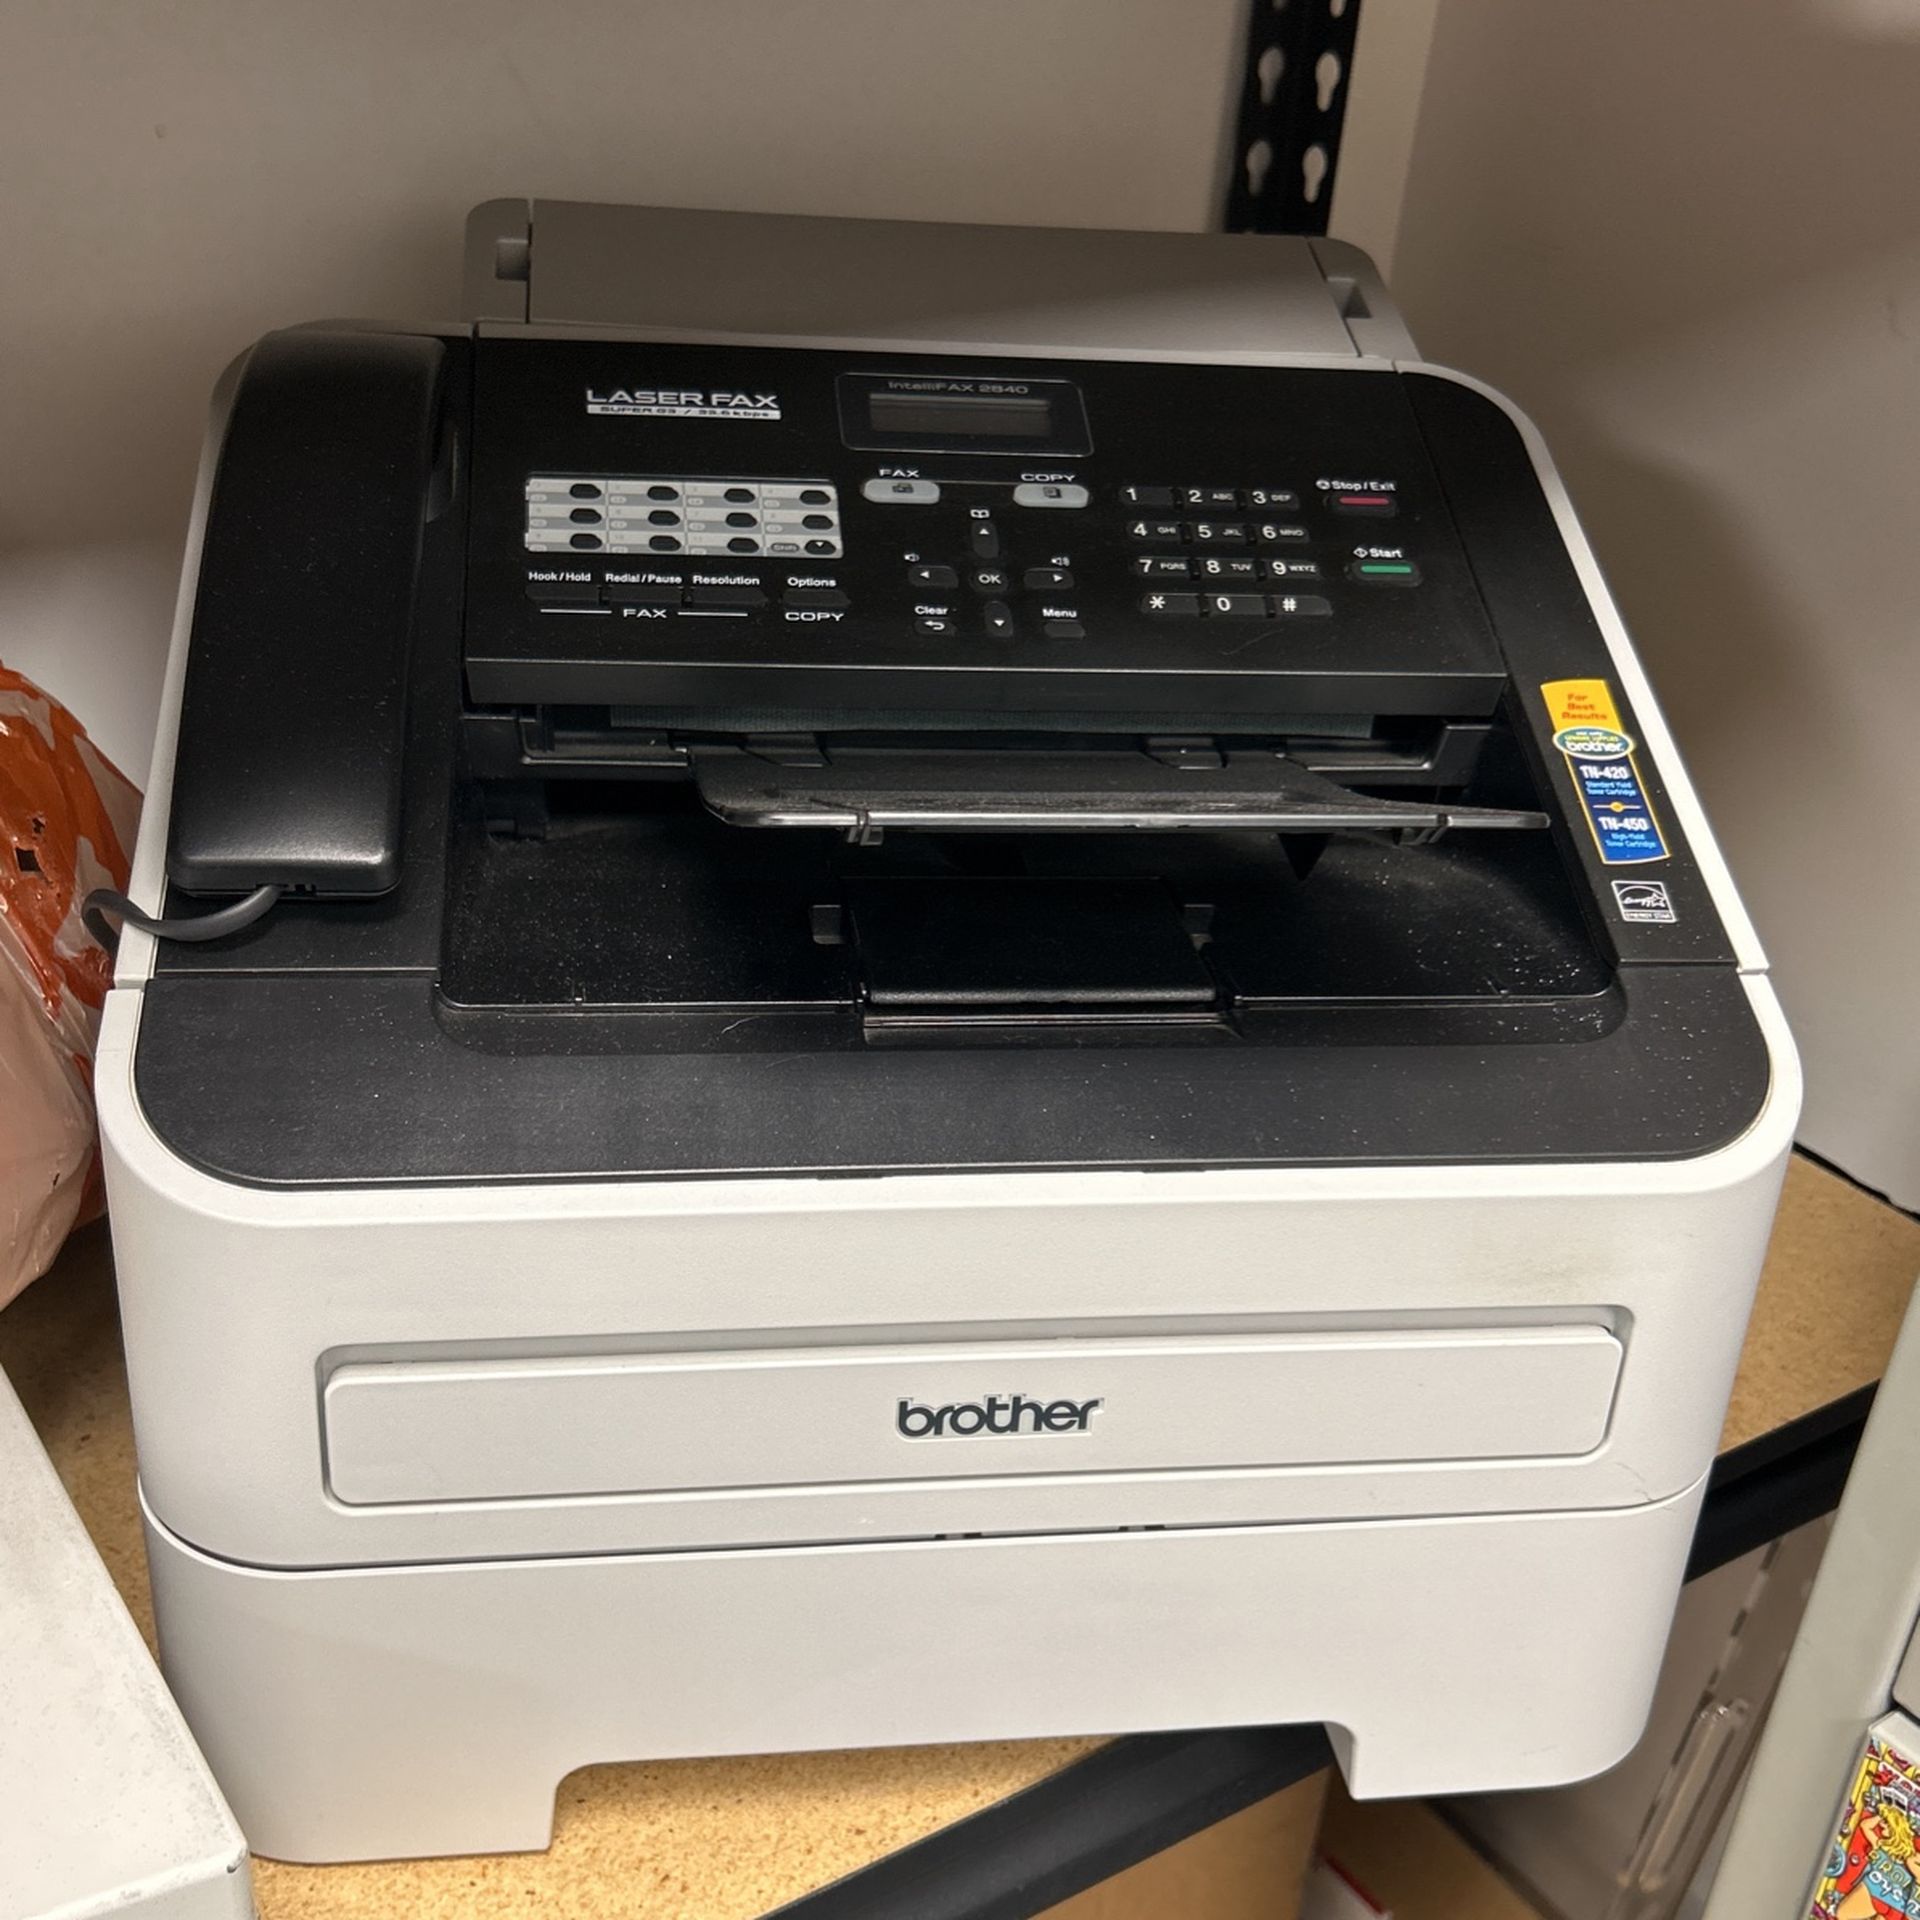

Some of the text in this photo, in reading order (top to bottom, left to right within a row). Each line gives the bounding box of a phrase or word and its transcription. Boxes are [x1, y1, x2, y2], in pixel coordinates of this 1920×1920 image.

[888, 381, 974, 393] IntelliFAX
[586, 389, 779, 409] LASER FAX
[879, 468, 920, 478] FAX
[1021, 473, 1076, 482] COPY
[1331, 480, 1361, 491] Stop
[1370, 481, 1396, 491] Exit
[1127, 487, 1137, 501] 1
[1189, 490, 1202, 503] 2
[1253, 491, 1267, 504] 3
[1134, 524, 1147, 536] 4
[1198, 525, 1212, 538] 5
[1263, 526, 1277, 539] 6
[1369, 548, 1402, 558] Start
[1139, 559, 1152, 573] 7
[1206, 560, 1251, 573] 8 TUV
[1272, 562, 1286, 575] 9
[528, 571, 558, 582] Hook
[565, 572, 592, 582] Hold
[605, 573, 640, 583] Redial
[648, 574, 682, 584] Pause
[692, 575, 760, 586] Resolution
[979, 574, 1001, 584] OK
[787, 577, 837, 588] Options
[1217, 597, 1231, 611] 0
[623, 608, 667, 619] FAX
[785, 611, 844, 622] COPY
[915, 606, 948, 616] Clear
[1042, 607, 1078, 618] Menu
[1567, 693, 1588, 702] For
[1567, 702, 1596, 711] Best
[1561, 711, 1607, 720] Results
[899, 1396, 1101, 1437] brother
